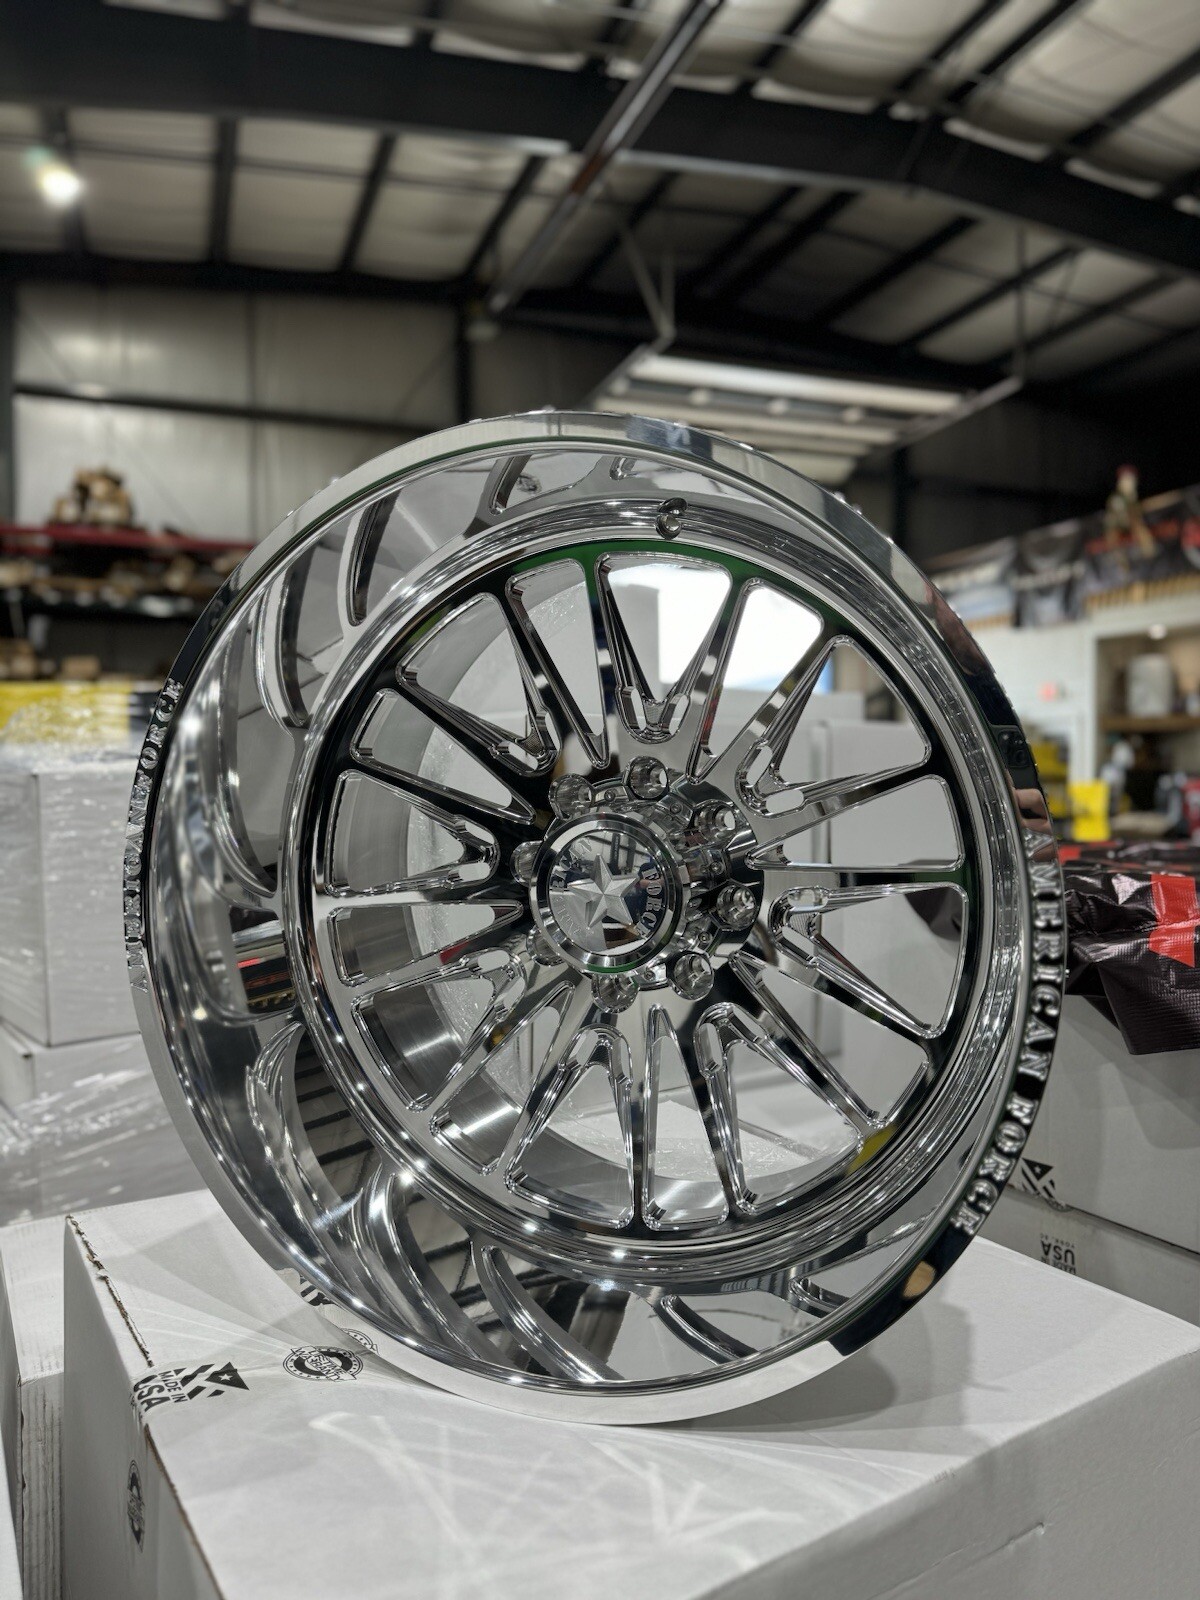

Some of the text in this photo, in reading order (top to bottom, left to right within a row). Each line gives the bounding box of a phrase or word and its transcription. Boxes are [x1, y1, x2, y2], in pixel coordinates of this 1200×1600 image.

[123, 678, 184, 992] AMERICAN FORCE
[634, 869, 662, 939] FORCE
[951, 830, 1063, 1235] AMERICAN FORCE
[1041, 1241, 1075, 1265] USA
[133, 1374, 171, 1412] USA
[171, 1393, 188, 1403] IN
